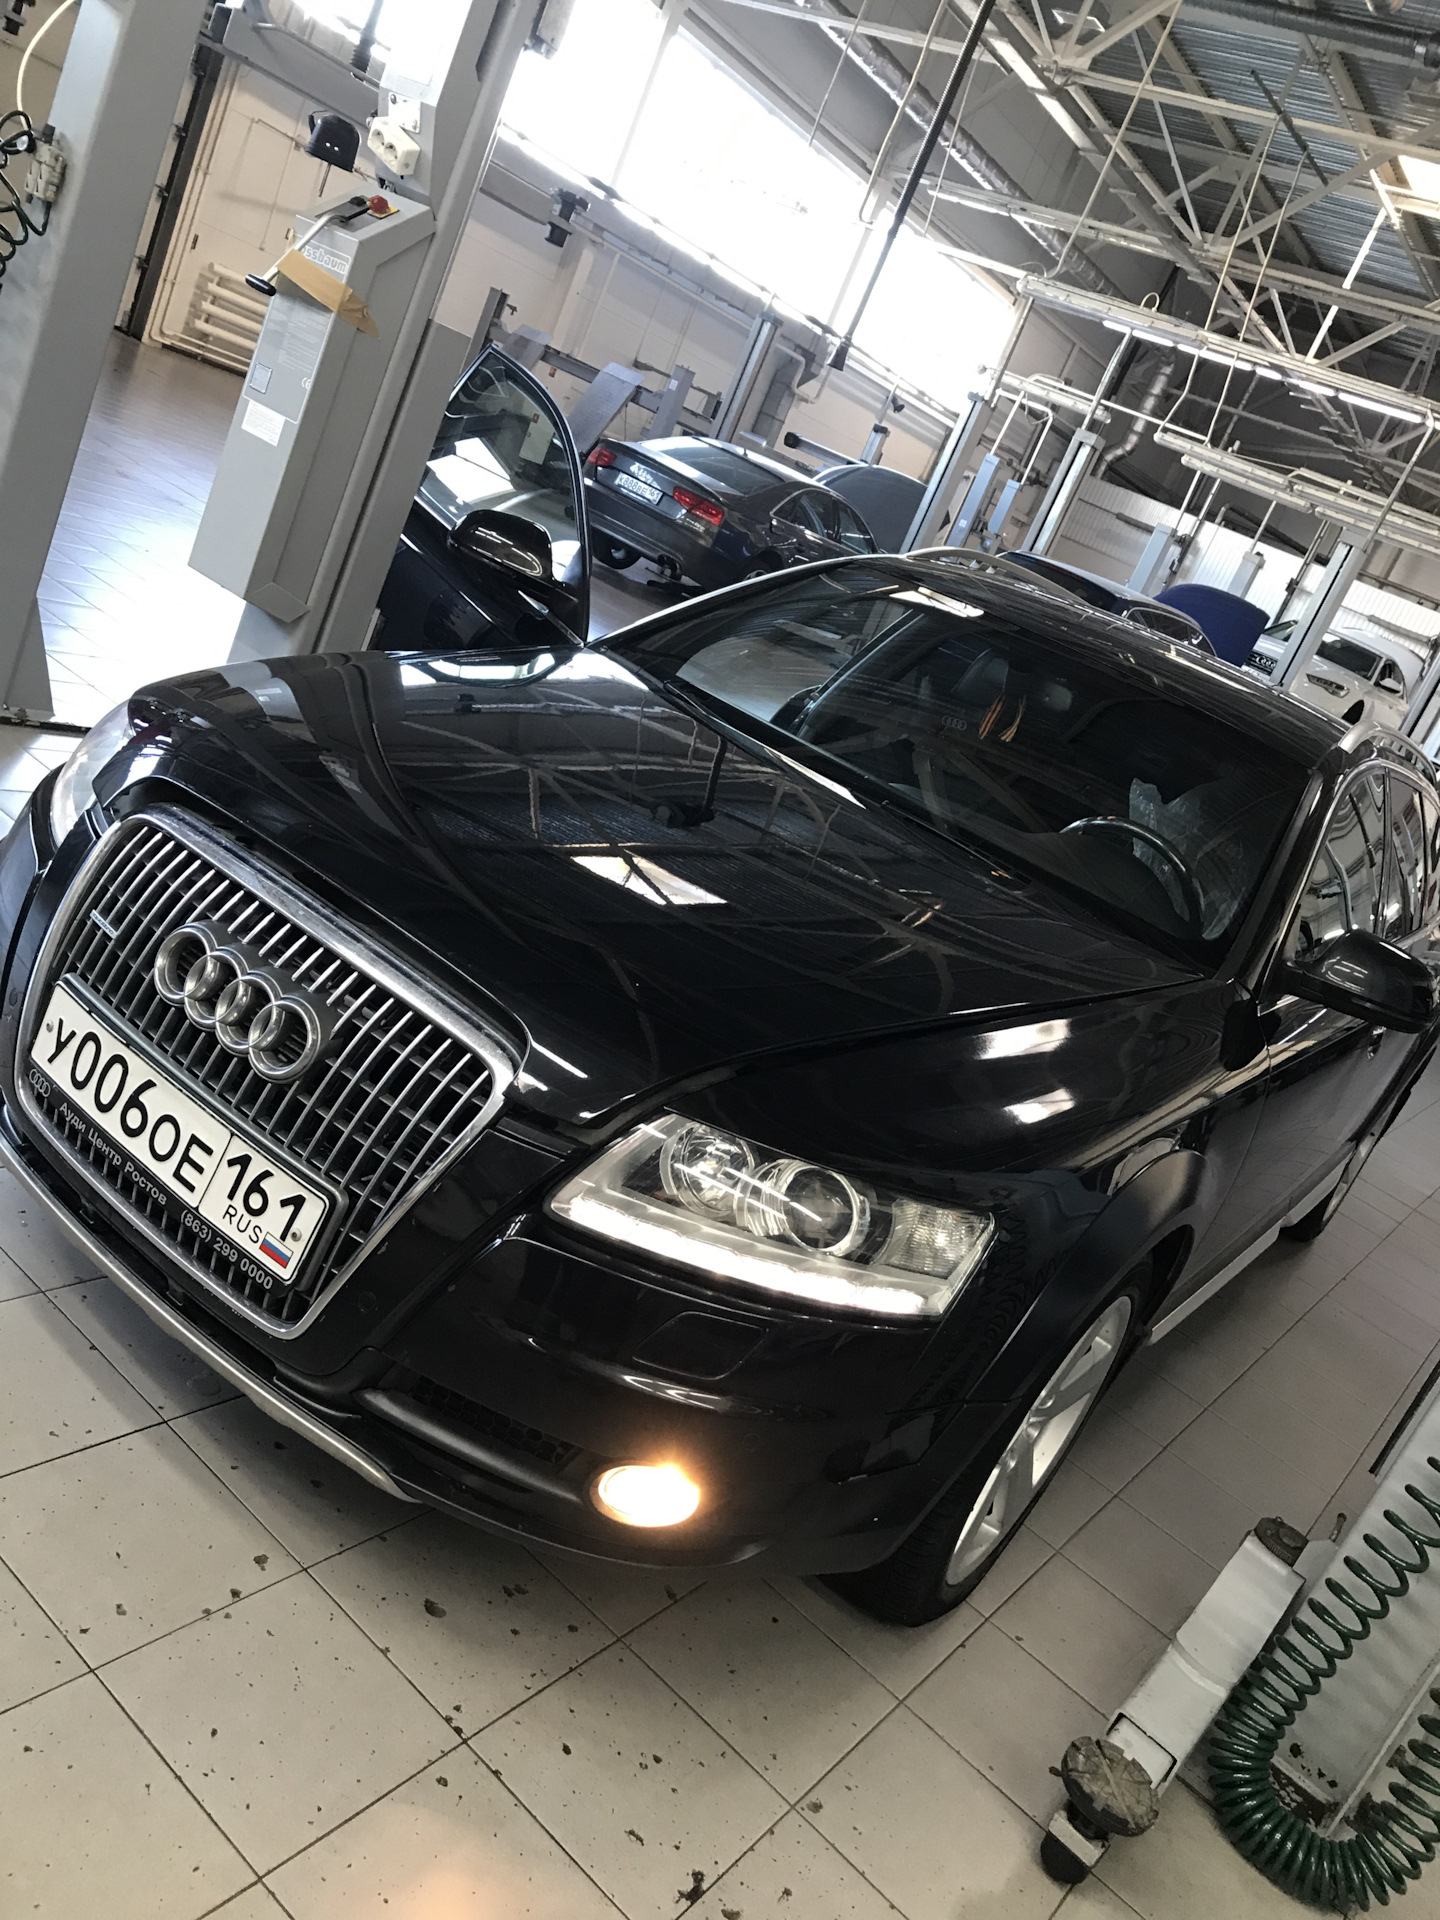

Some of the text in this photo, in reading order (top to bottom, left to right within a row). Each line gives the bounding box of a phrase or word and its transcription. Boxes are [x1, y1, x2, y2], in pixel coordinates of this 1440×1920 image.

[59, 1102, 273, 1290] Ауди Центр Ростов (863) 299 0000
[222, 1203, 263, 1244] RUS
[226, 1152, 307, 1243] 161
